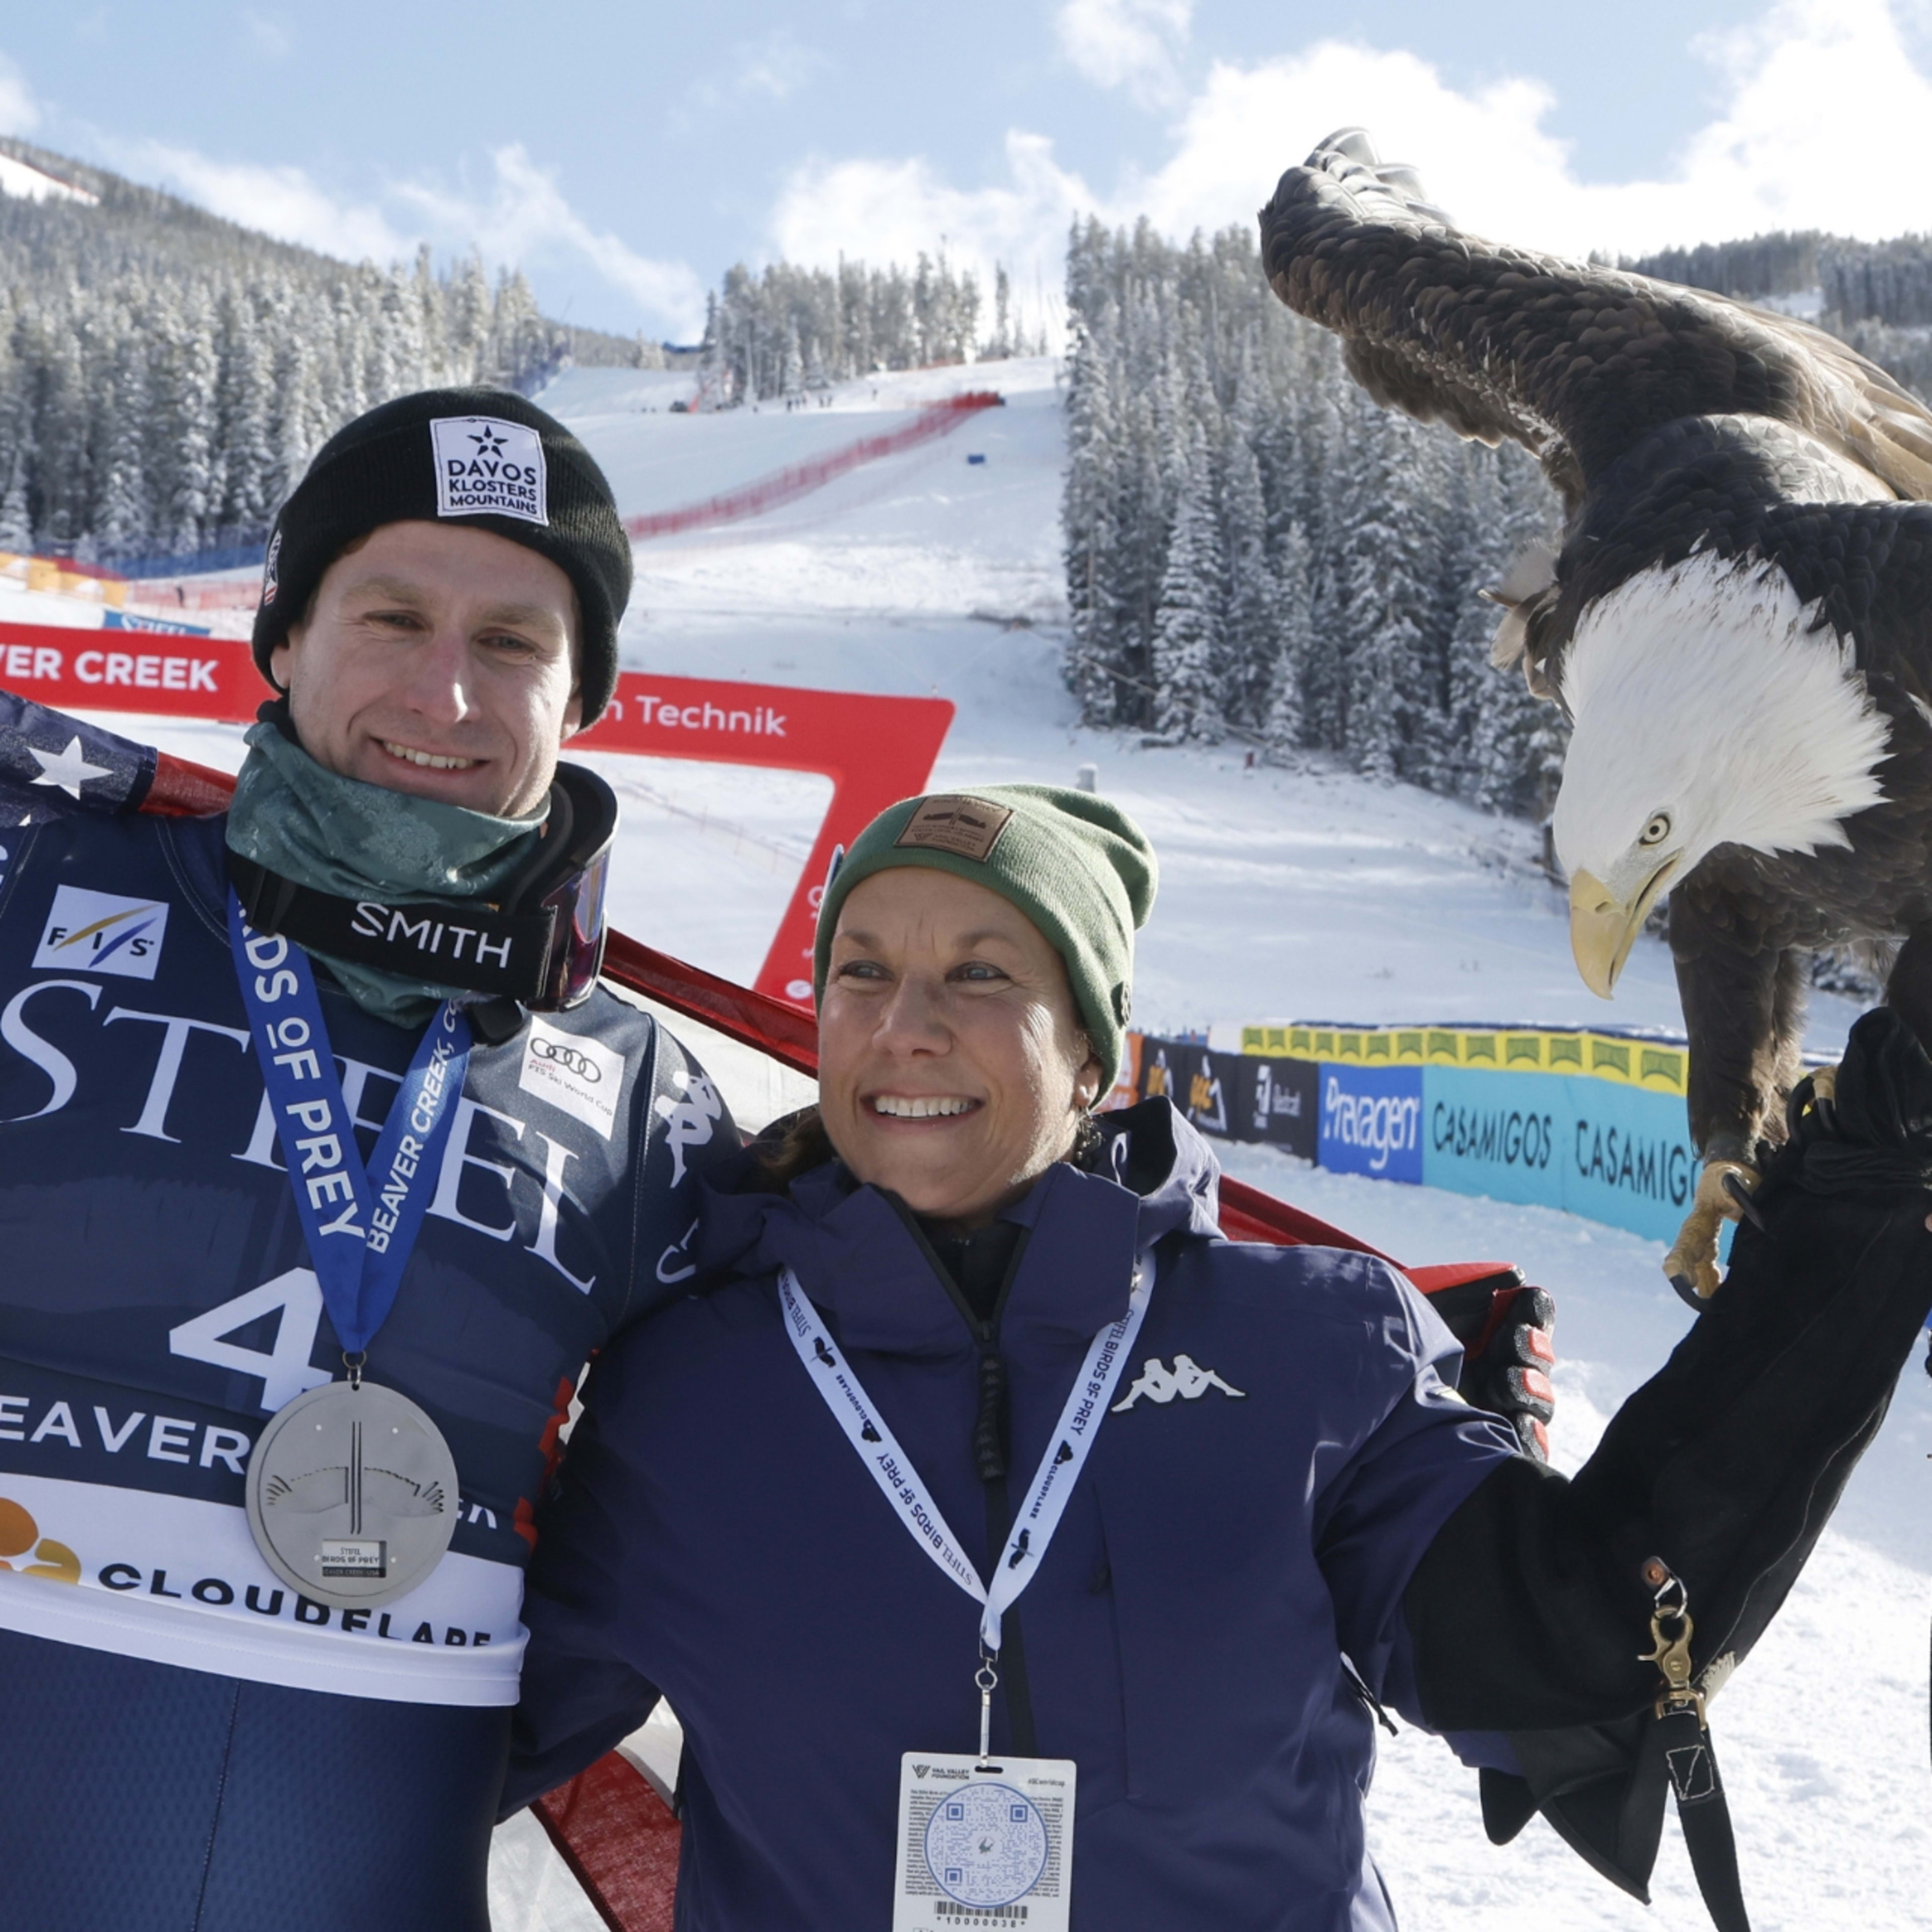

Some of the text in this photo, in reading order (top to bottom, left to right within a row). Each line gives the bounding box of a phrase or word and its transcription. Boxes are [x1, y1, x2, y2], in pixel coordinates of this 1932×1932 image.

[447, 459, 536, 485] DAVOS
[448, 479, 536, 501] KLOSTERS
[449, 495, 537, 514] MOUNTAINS
[74, 652, 219, 692] CREEK
[635, 695, 786, 737] Technik
[47, 928, 154, 957] FIS
[351, 902, 512, 968] SMITH
[266, 1017, 321, 1080] OF
[528, 1063, 614, 1117] FIS Ski World Cup
[1324, 1076, 1420, 1171] Prevagen
[1432, 1102, 1553, 1169] CASAMIGOS
[286, 1099, 366, 1237] PREY
[367, 1136, 424, 1254] BEAVER
[169, 1267, 334, 1413] 4
[1092, 1340, 1119, 1382] BIRDS
[836, 1375, 868, 1421] CLOUDFLARE
[1087, 1381, 1101, 1399] OF
[1070, 1398, 1094, 1436] PREY
[1029, 1463, 1059, 1519] CLOUDFLARE
[876, 1453, 973, 1585] STIFEL BIRDS OF PREY
